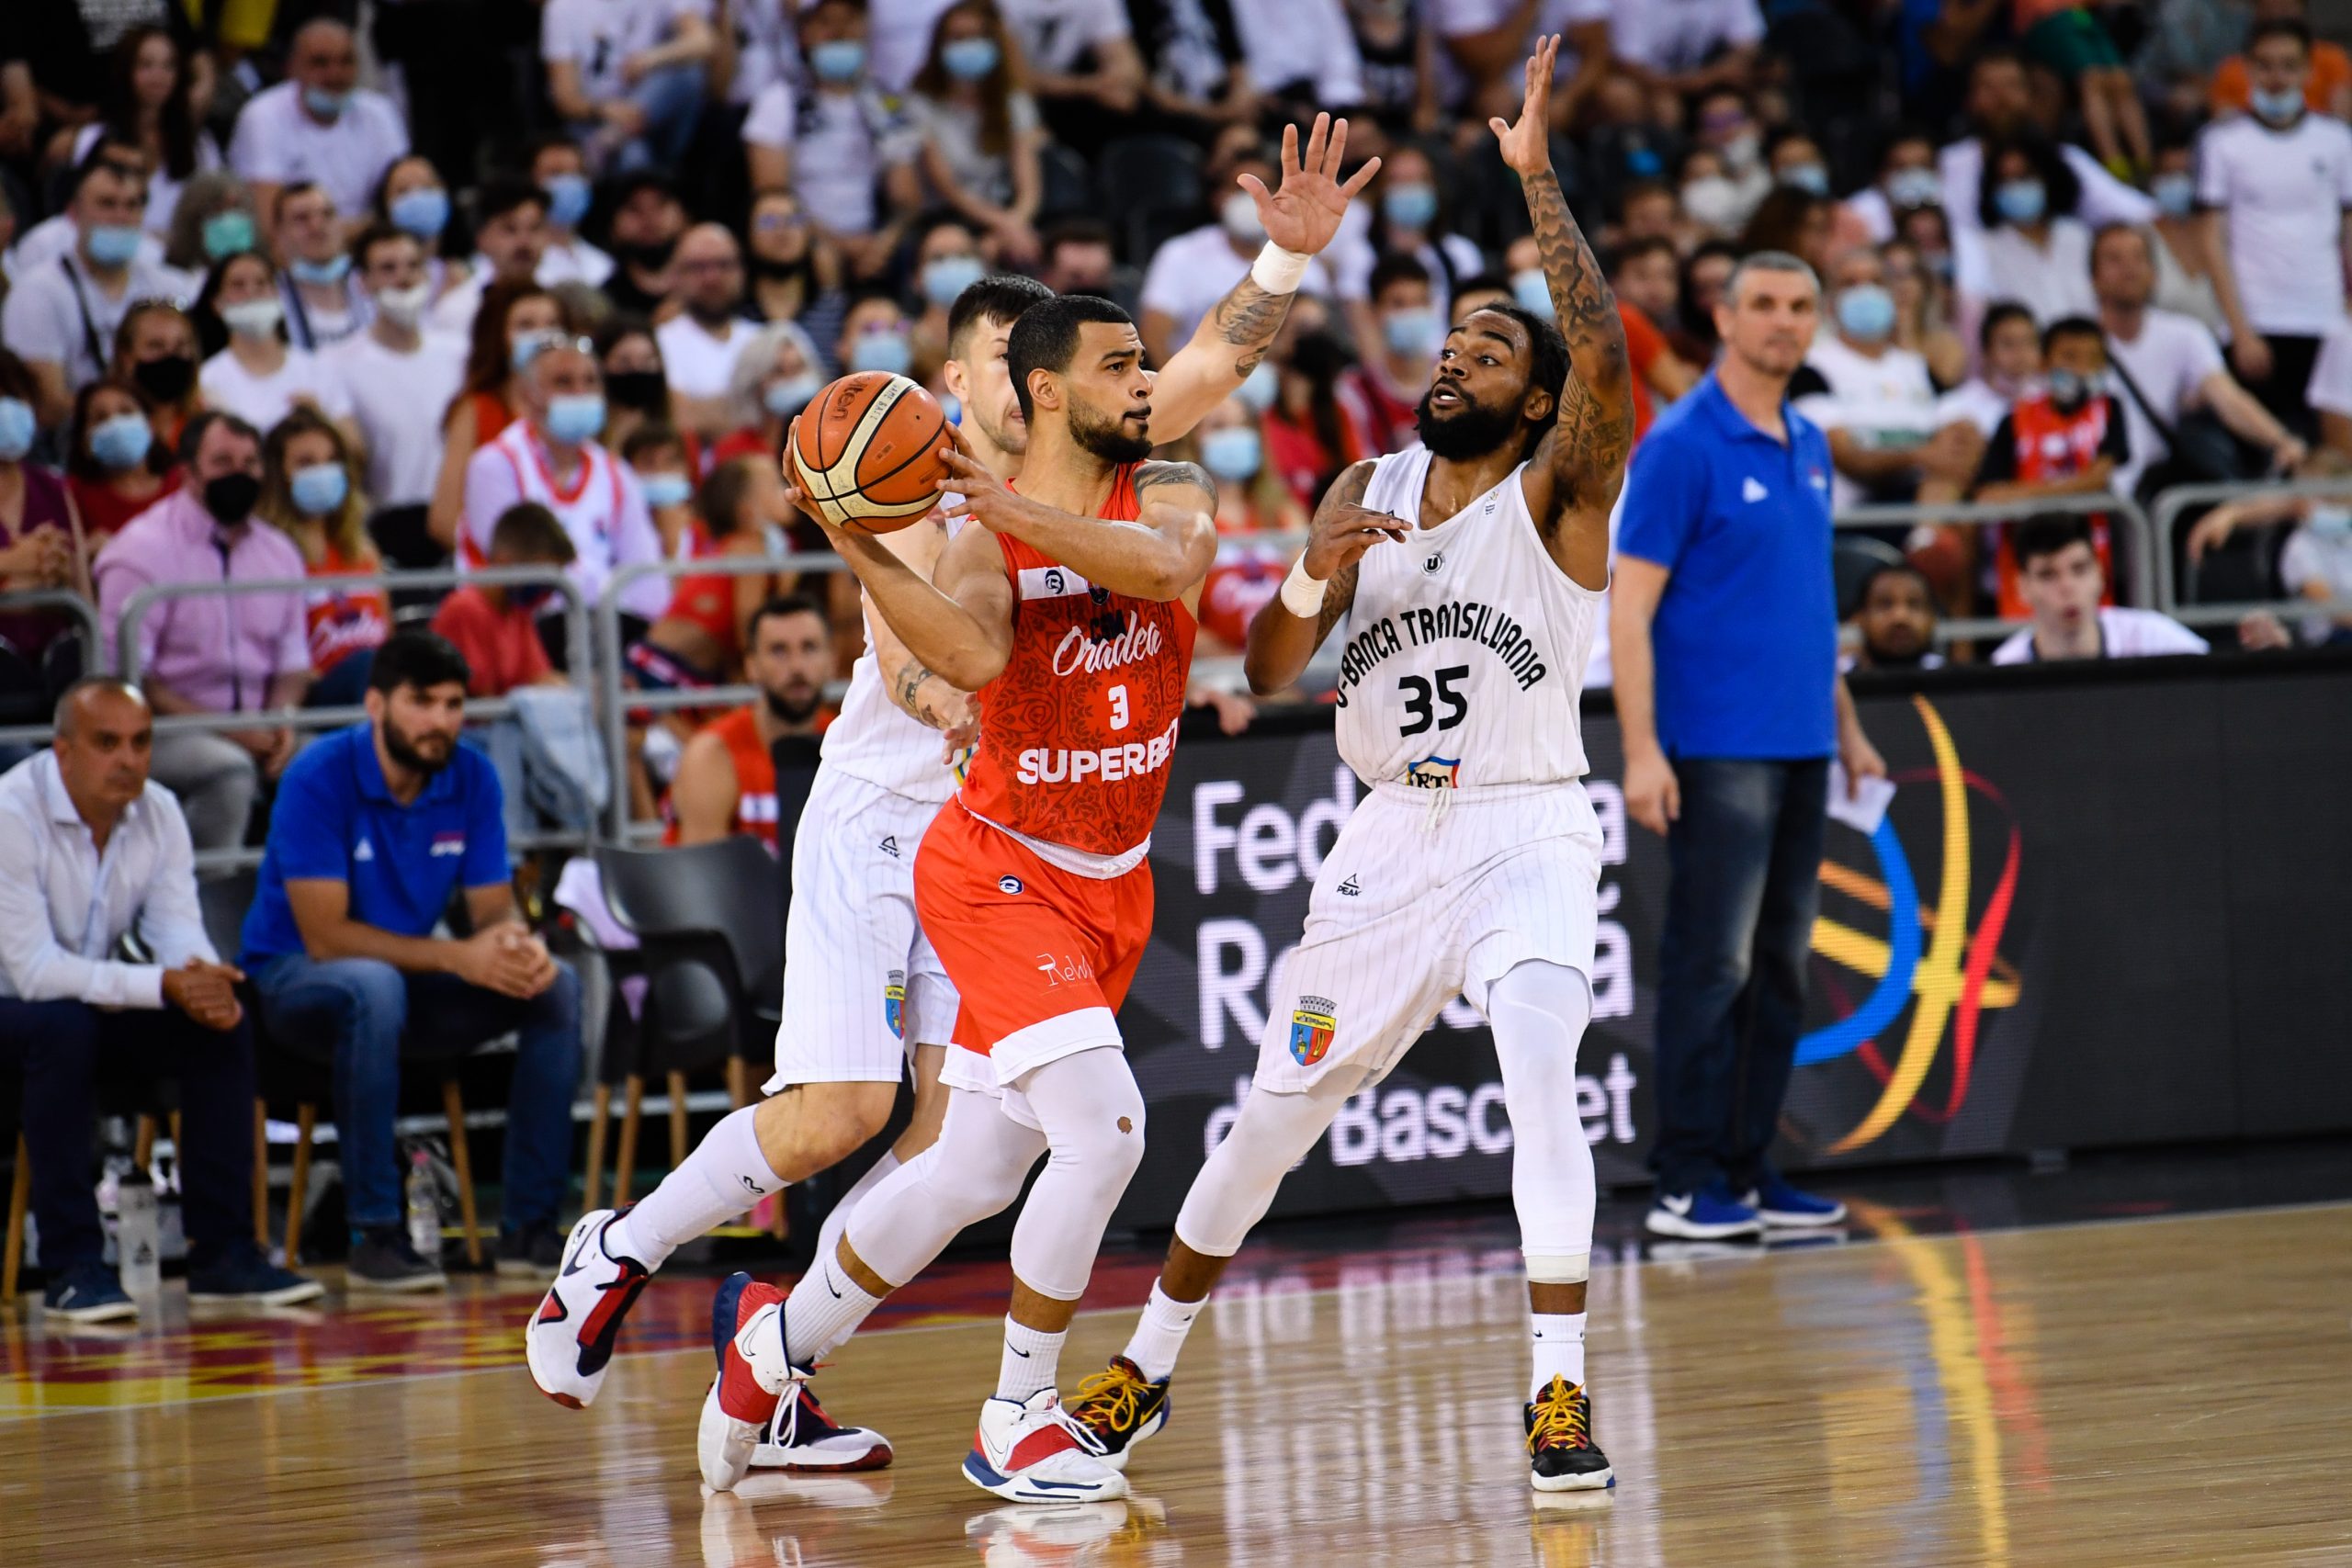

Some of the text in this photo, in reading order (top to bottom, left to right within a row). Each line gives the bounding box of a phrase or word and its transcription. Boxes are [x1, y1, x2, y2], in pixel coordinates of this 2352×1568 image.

[1427, 557, 1439, 570] U
[1053, 609, 1162, 676] Oradea
[1399, 600, 1546, 692] TRANSILVANIA
[1107, 683, 1130, 731] 3
[1397, 664, 1469, 738] 35
[1016, 716, 1179, 784] SUPERBET
[1337, 885, 1362, 897] PEAK
